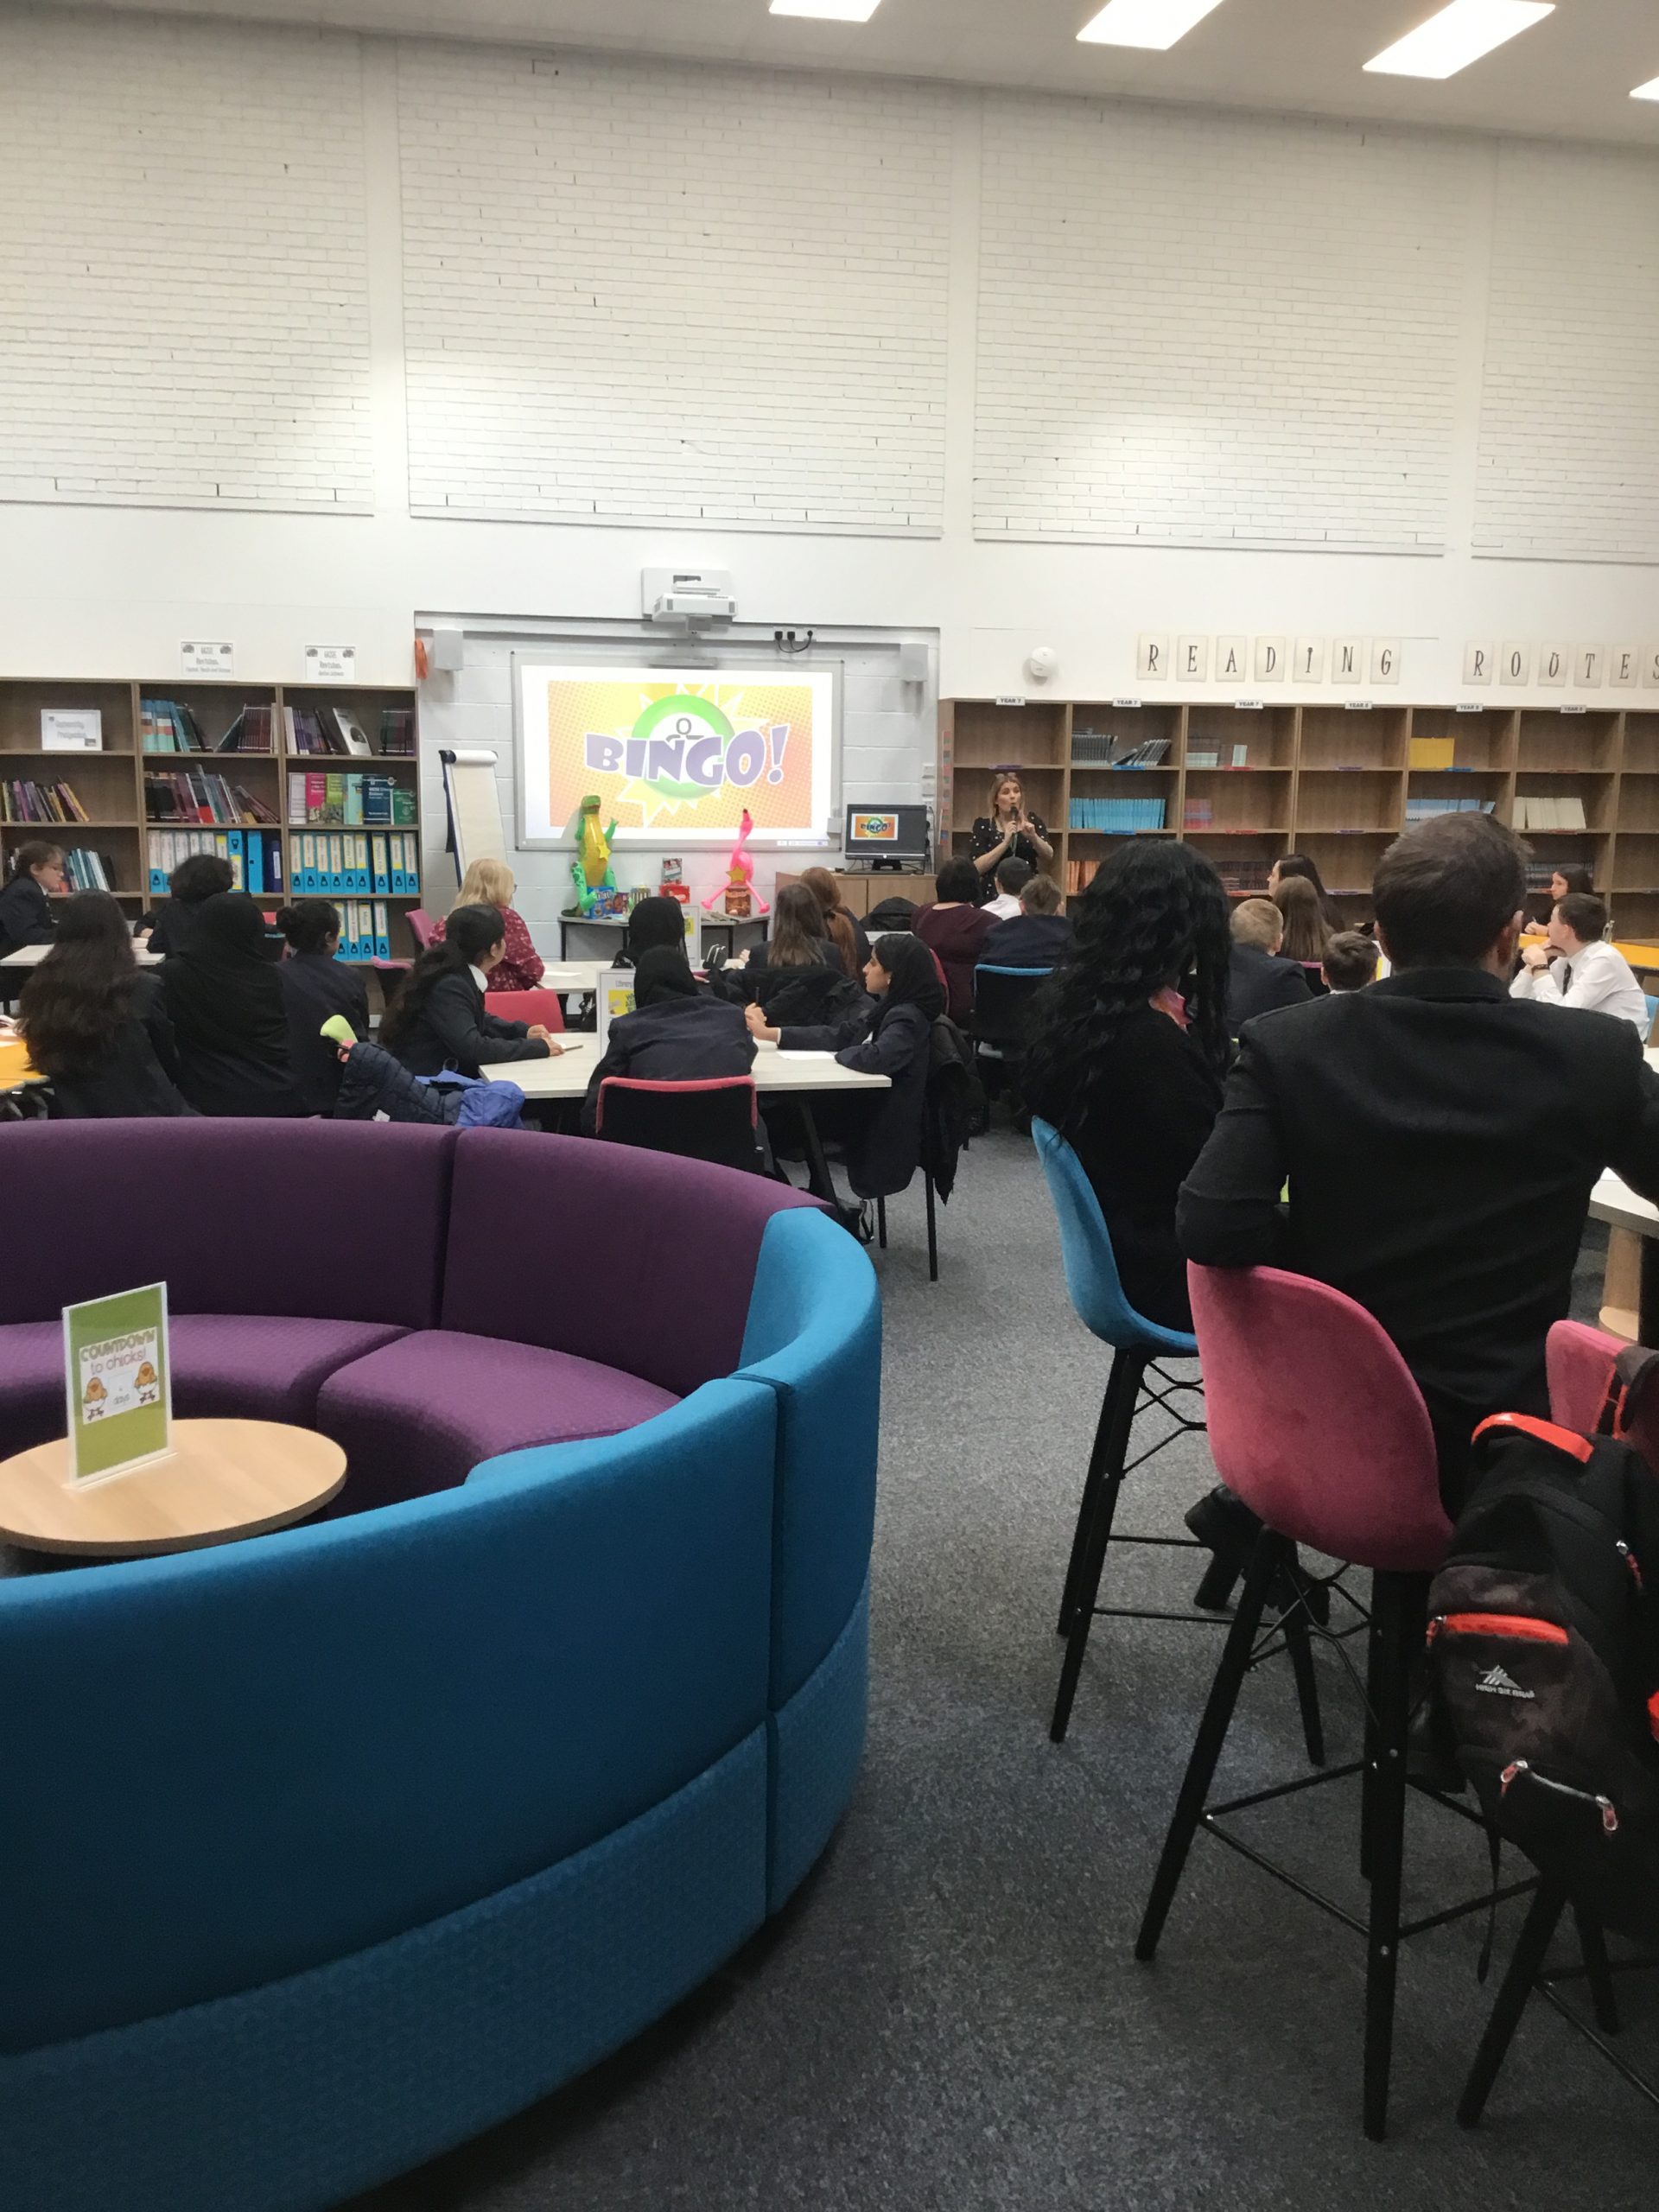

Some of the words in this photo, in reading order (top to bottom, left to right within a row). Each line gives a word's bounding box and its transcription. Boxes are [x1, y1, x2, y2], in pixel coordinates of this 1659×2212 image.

[1147, 644, 1394, 677] READING
[1472, 650, 1659, 680] ROUTES
[585, 723, 790, 787] BINGO!
[81, 1330, 156, 1362] COUNTDOWN
[91, 1362, 104, 1376] to
